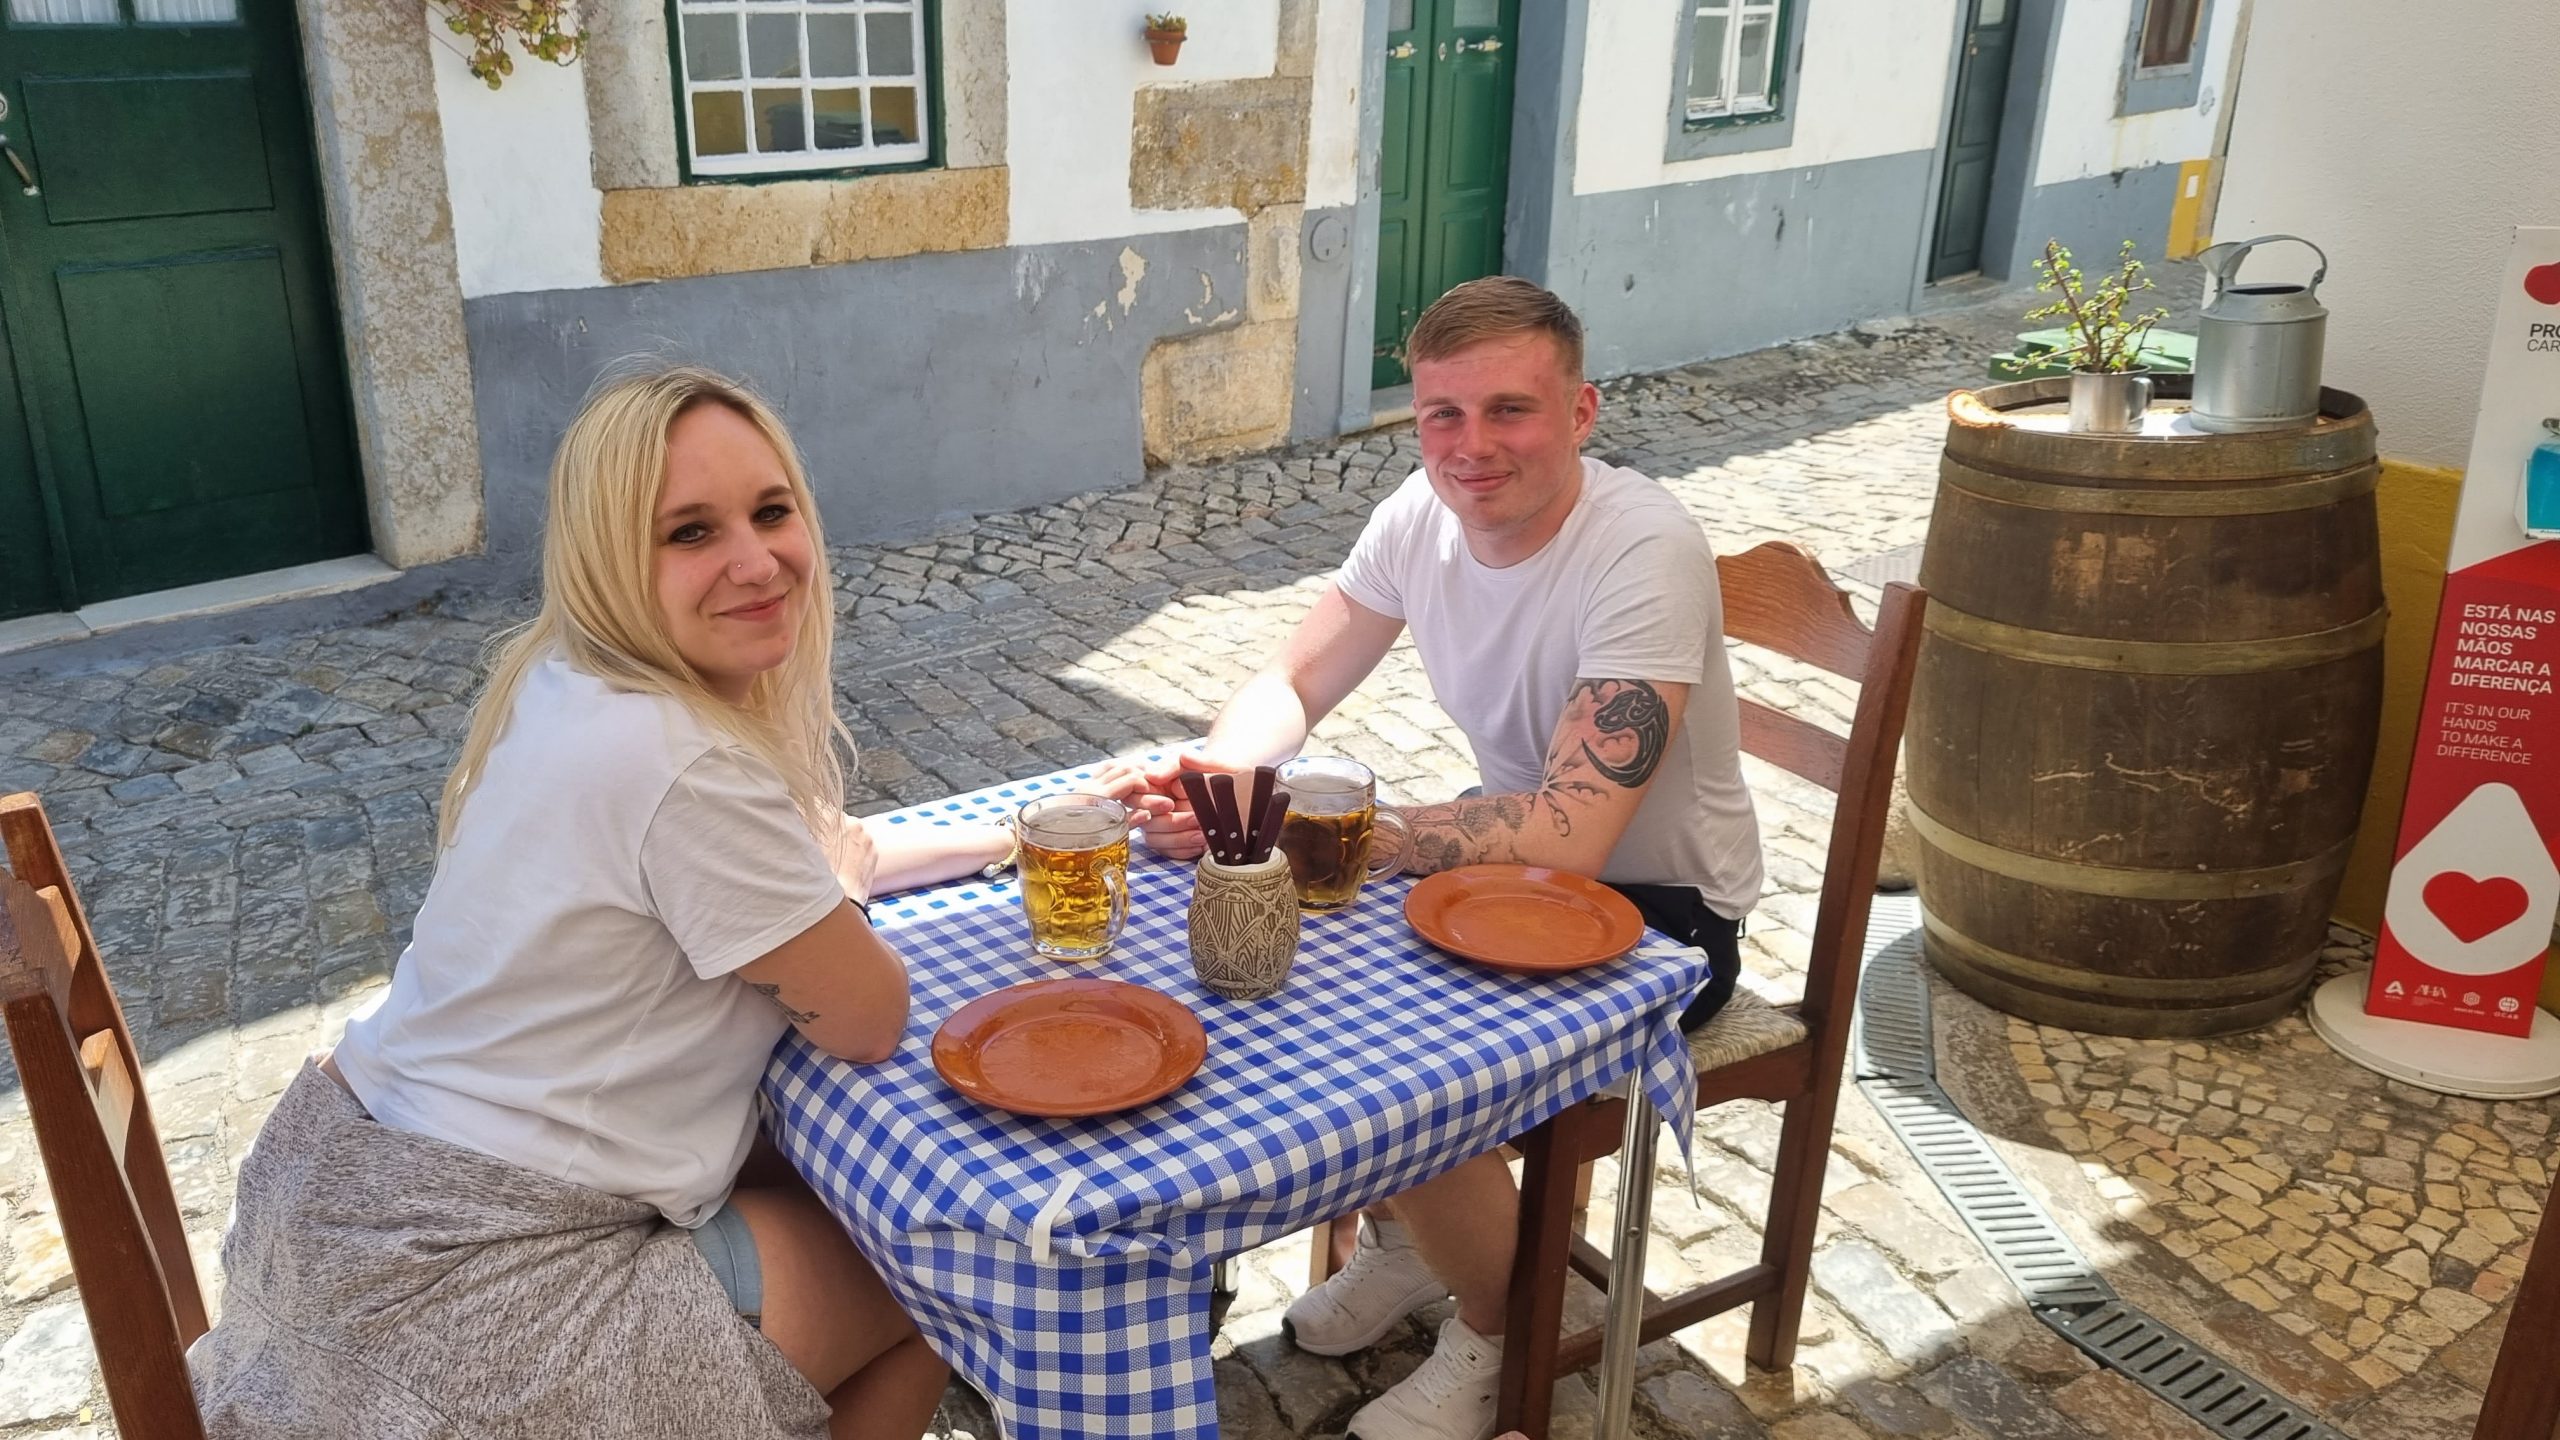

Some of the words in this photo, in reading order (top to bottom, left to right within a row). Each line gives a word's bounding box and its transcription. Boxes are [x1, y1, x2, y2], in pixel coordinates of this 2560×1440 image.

[2463, 604, 2511, 620] ESTÁ
[2516, 608, 2556, 623] NAS
[2460, 621, 2537, 639] NOSSAS
[2457, 638, 2513, 655] MÃOS
[2454, 656, 2534, 674] MARCAR
[2537, 663, 2551, 676] A
[2450, 672, 2552, 695] DIFERENÇA
[2477, 706, 2494, 717] IN
[2498, 707, 2531, 720] OUR
[2442, 716, 2497, 732] HANDS
[2441, 730, 2461, 743] TO
[2464, 733, 2509, 748] MAKE
[2511, 738, 2523, 749] A
[2437, 744, 2532, 765] DIFFERENCE
